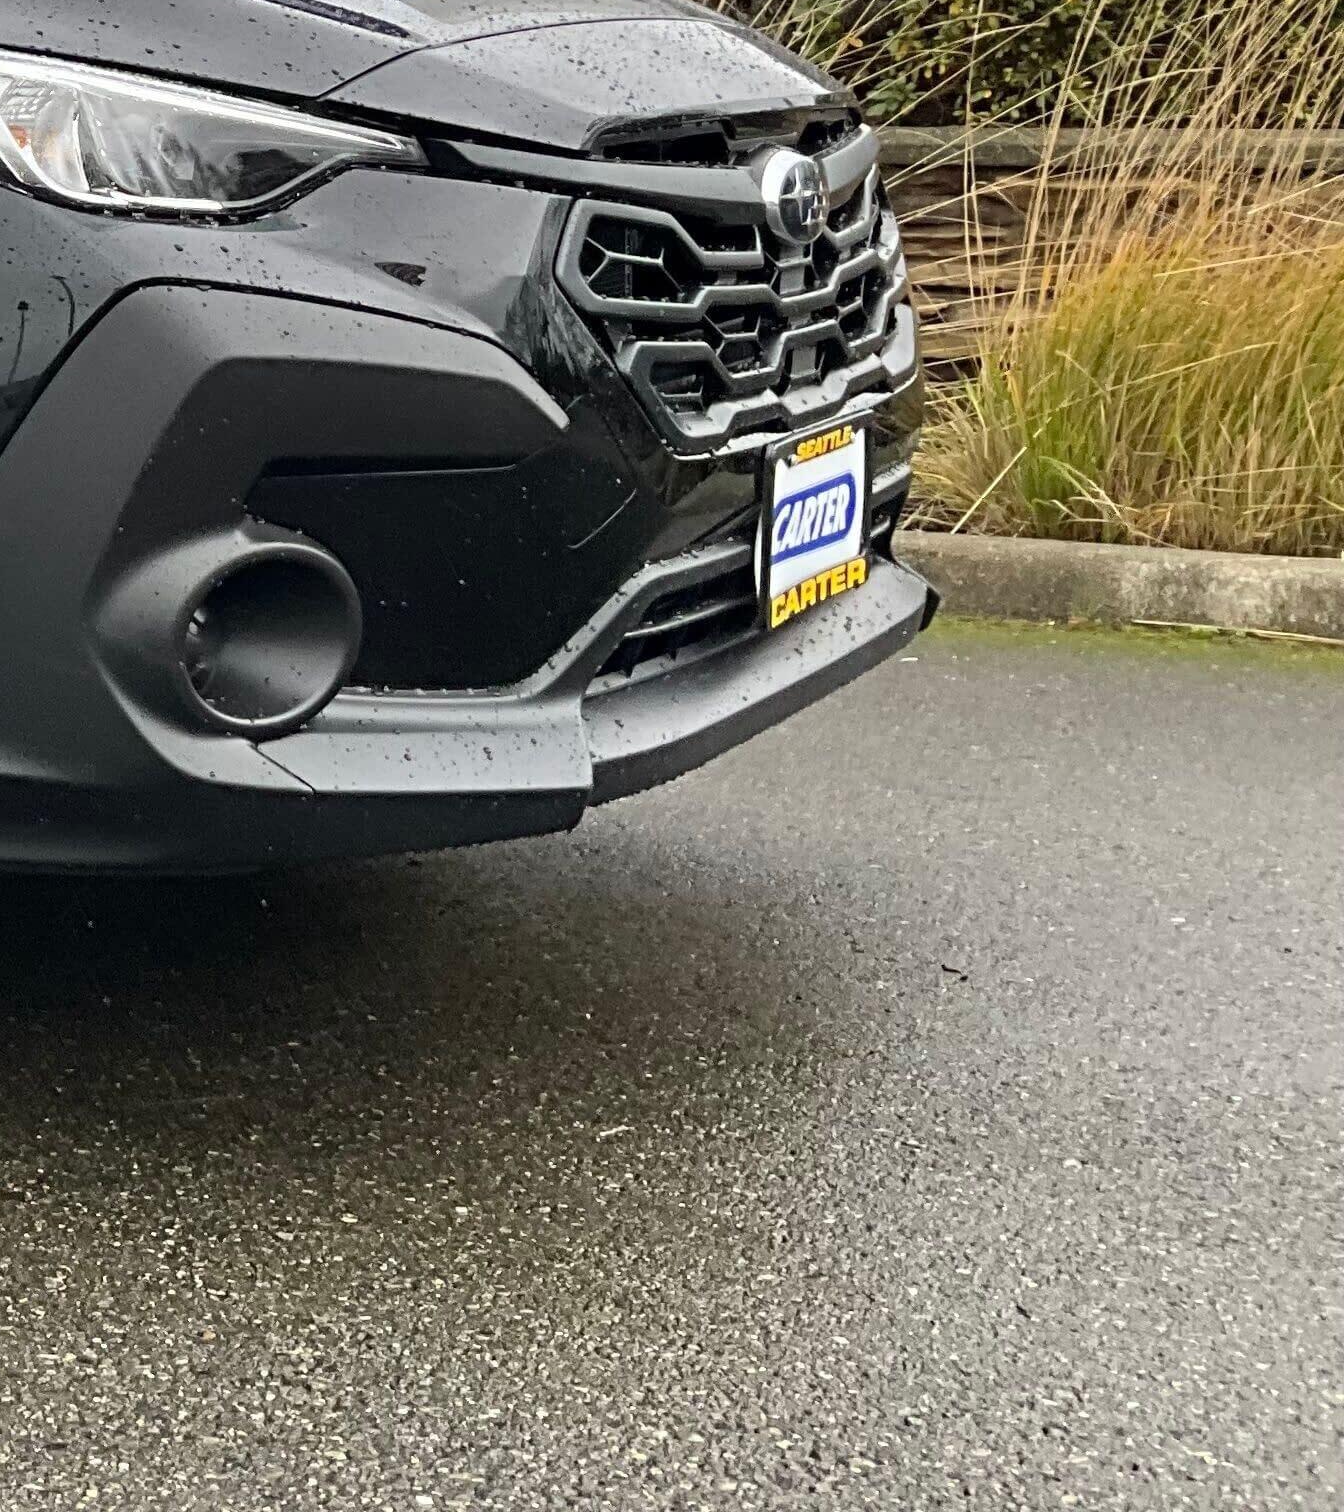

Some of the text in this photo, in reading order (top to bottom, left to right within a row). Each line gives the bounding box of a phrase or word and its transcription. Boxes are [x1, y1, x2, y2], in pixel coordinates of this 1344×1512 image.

[795, 425, 853, 461] SEATTLE
[773, 483, 851, 554] CARTER
[771, 558, 867, 628] CARTER
